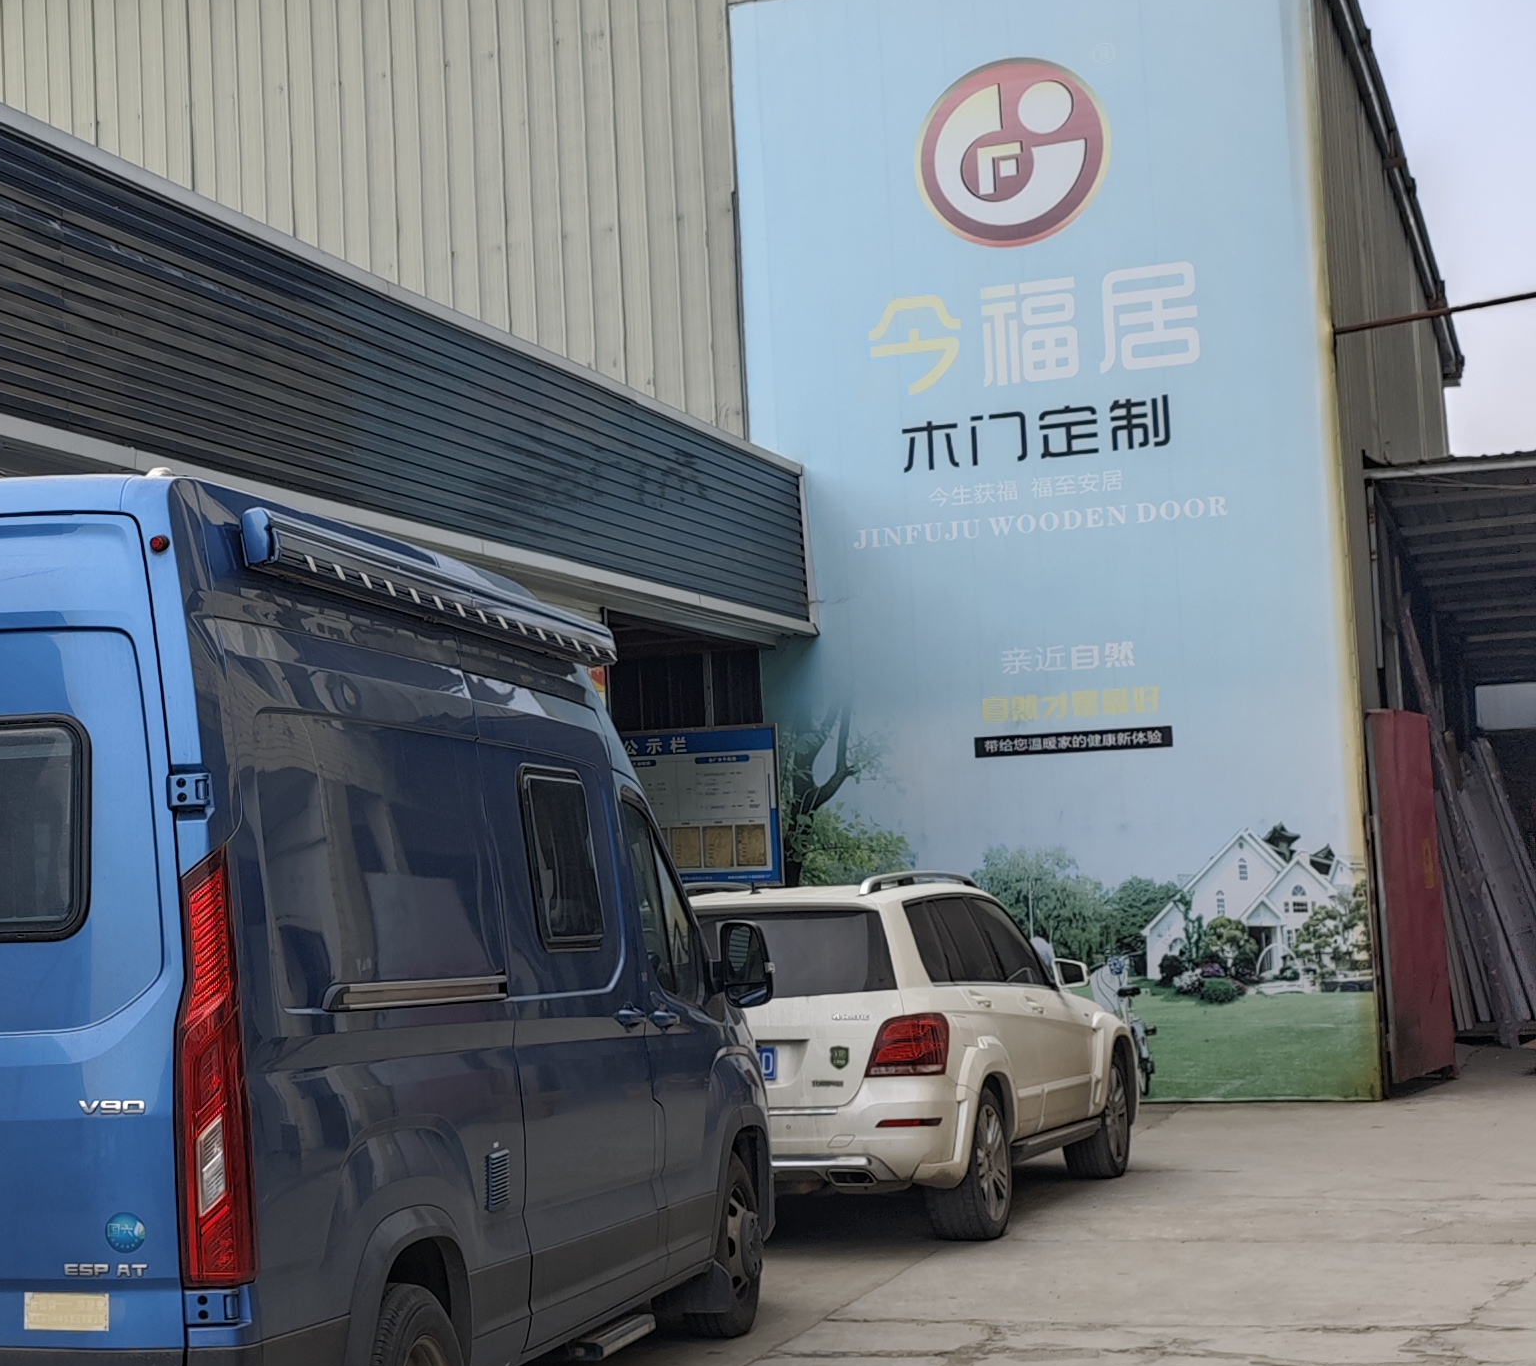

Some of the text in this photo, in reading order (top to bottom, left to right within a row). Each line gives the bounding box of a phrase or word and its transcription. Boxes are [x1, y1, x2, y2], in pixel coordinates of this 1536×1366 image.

[868, 261, 1200, 395] 今福居
[901, 394, 1172, 474] 木门定制
[928, 470, 1123, 508] 今生获福 福至安居
[853, 495, 1229, 550] JINFUJU WOODEN DOOR
[1001, 641, 1135, 675] 亲近自然
[624, 736, 687, 755] 公示栏
[984, 730, 1162, 753] 带给您温暖家的健康新体验
[79, 1100, 145, 1114] V90
[64, 1263, 148, 1277] ESP AT
